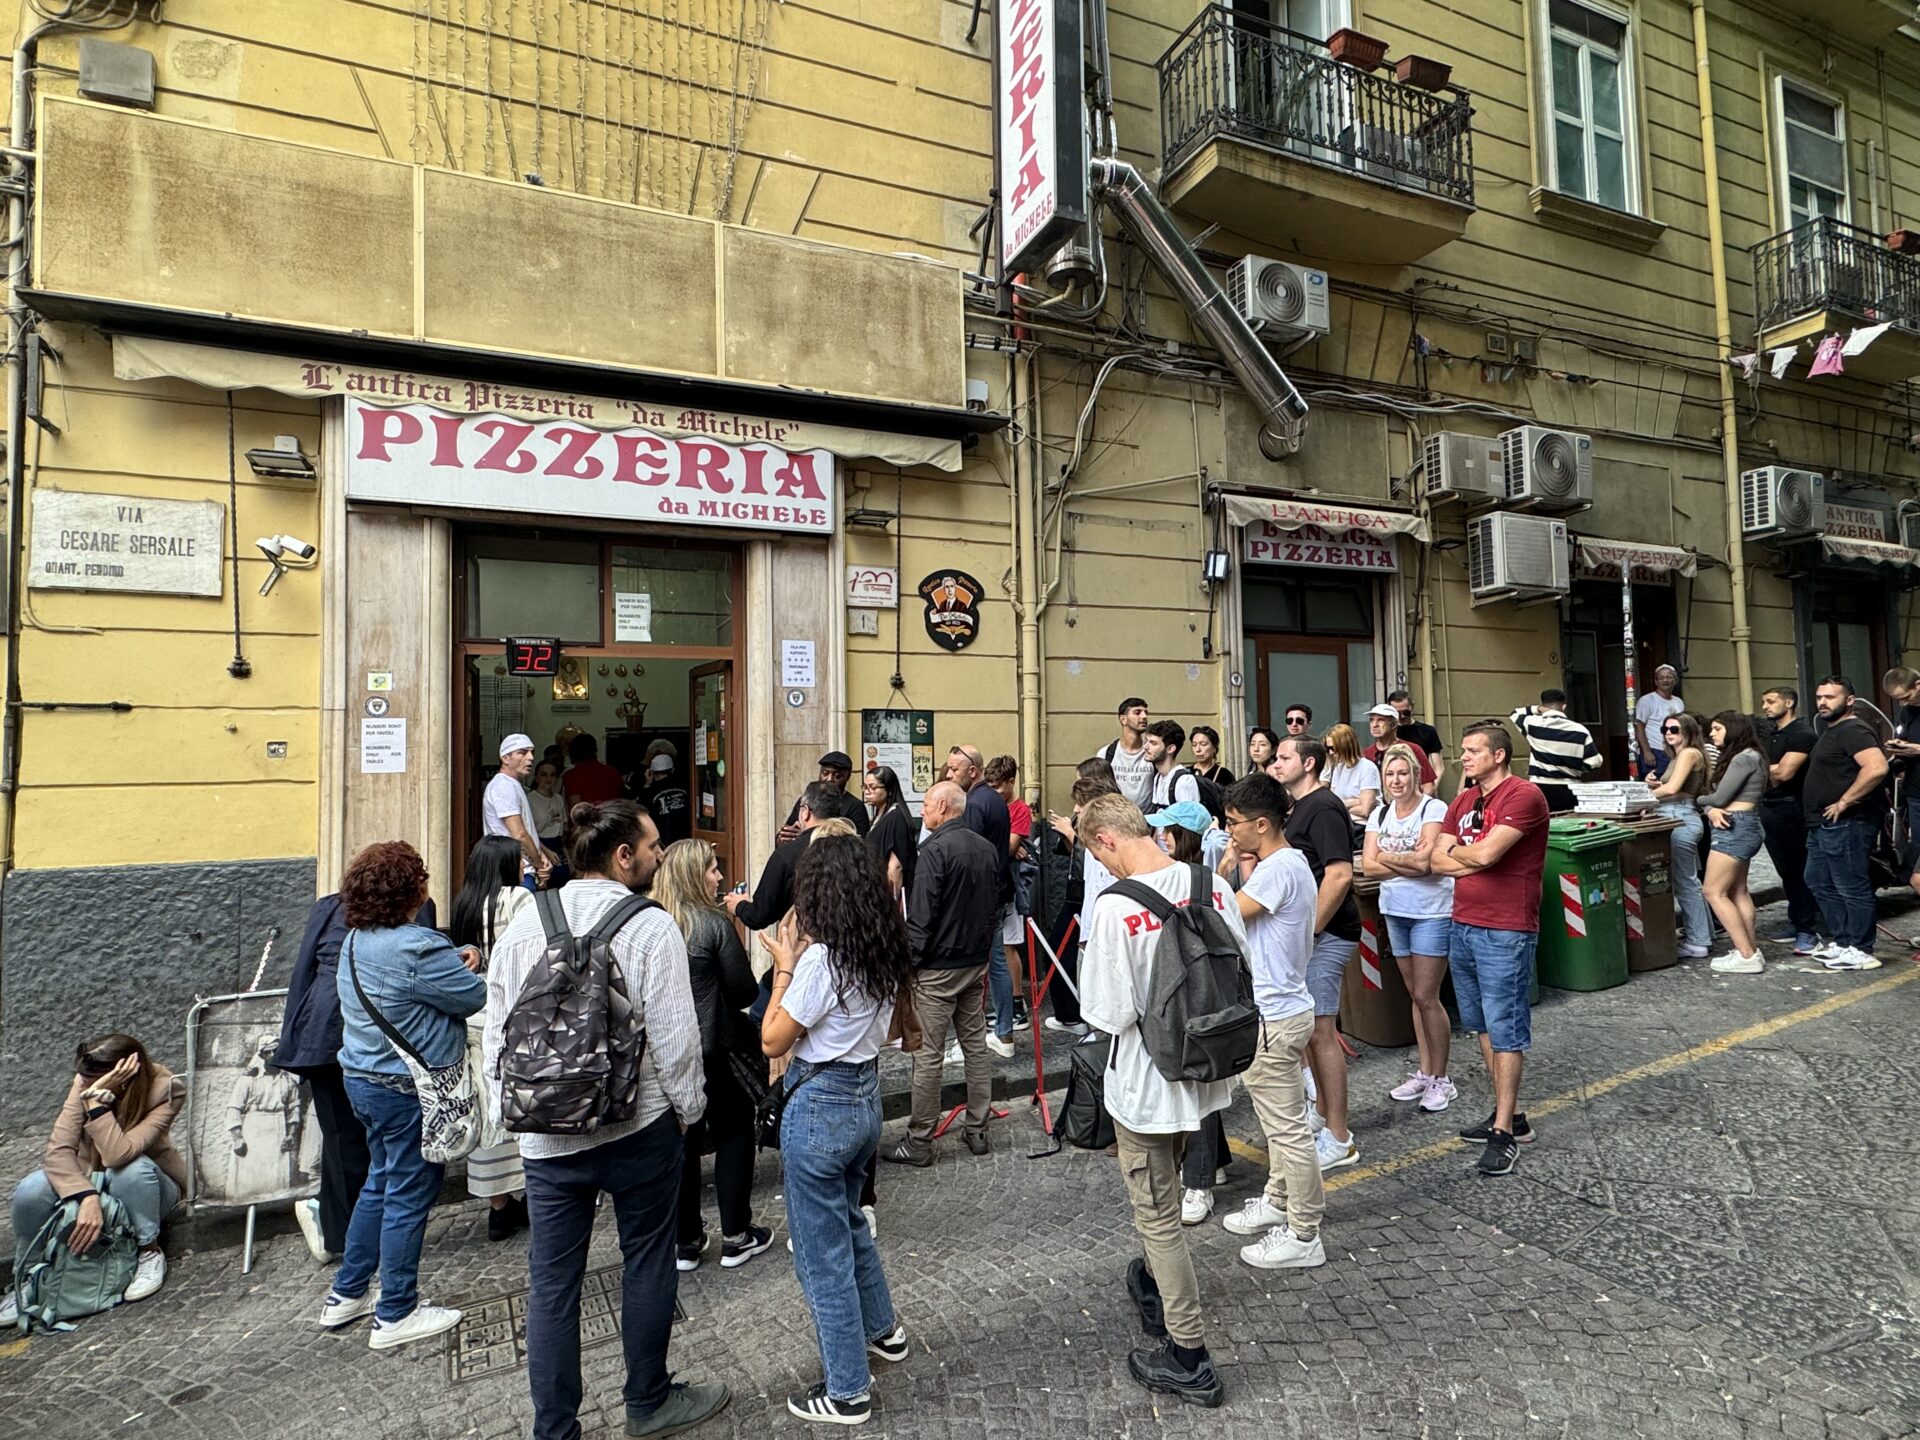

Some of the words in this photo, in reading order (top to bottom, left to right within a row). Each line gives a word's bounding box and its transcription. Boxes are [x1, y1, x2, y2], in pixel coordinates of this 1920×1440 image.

[1014, 192, 1052, 249] MICHELE
[300, 363, 452, 402] L'antica
[465, 381, 594, 419] Pizzeria
[356, 406, 828, 501] PIZZERIA
[117, 506, 143, 524] VIA
[657, 496, 690, 516] da
[698, 501, 828, 526] MICHELE
[1272, 504, 1390, 529] L'ANTICA
[60, 530, 120, 553] CESARE
[129, 535, 195, 557] SERSALE
[1251, 540, 1396, 568] PIZZERIA
[1600, 548, 1680, 566] PIZZERIA
[515, 646, 551, 670] 32
[1590, 861, 1613, 871] VETRO
